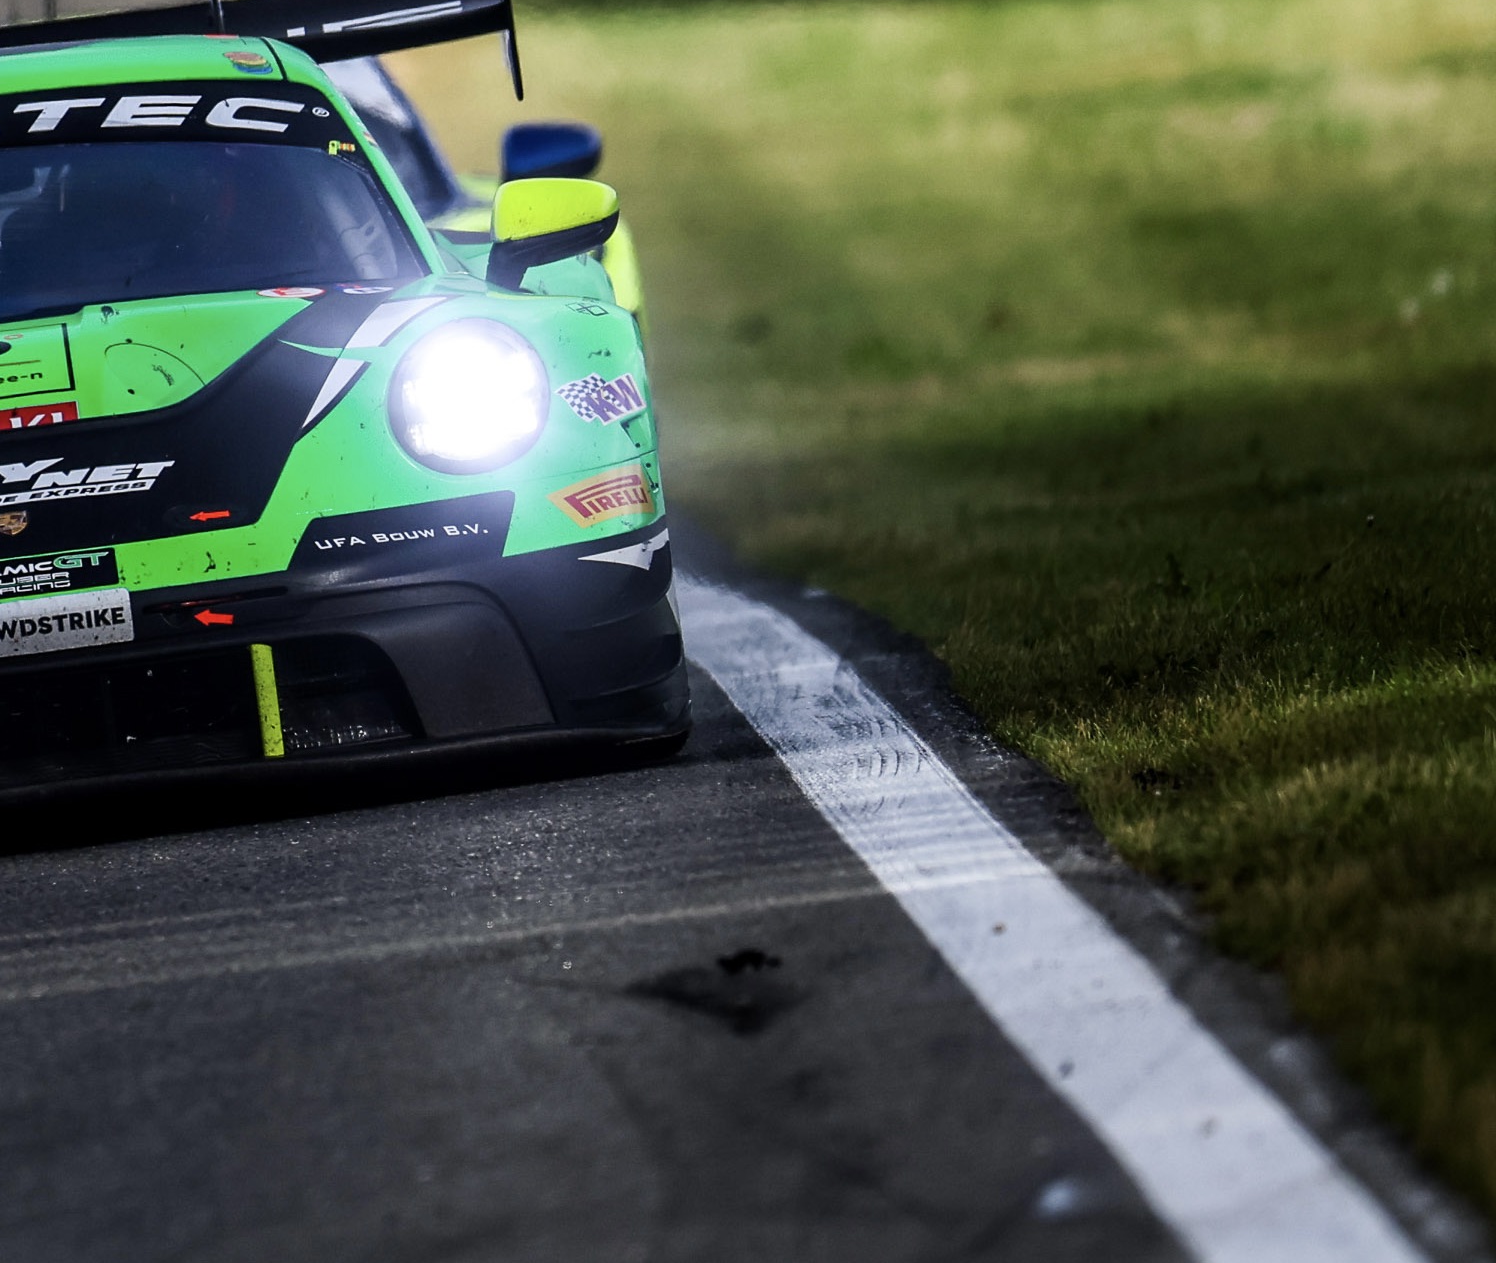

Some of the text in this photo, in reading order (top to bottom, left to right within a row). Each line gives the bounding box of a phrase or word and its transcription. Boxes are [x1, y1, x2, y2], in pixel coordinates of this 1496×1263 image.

[30, 481, 148, 500] EXPRESS
[563, 474, 649, 519] PIRELLI
[314, 536, 366, 550] UFA
[443, 523, 489, 536] B.V.
